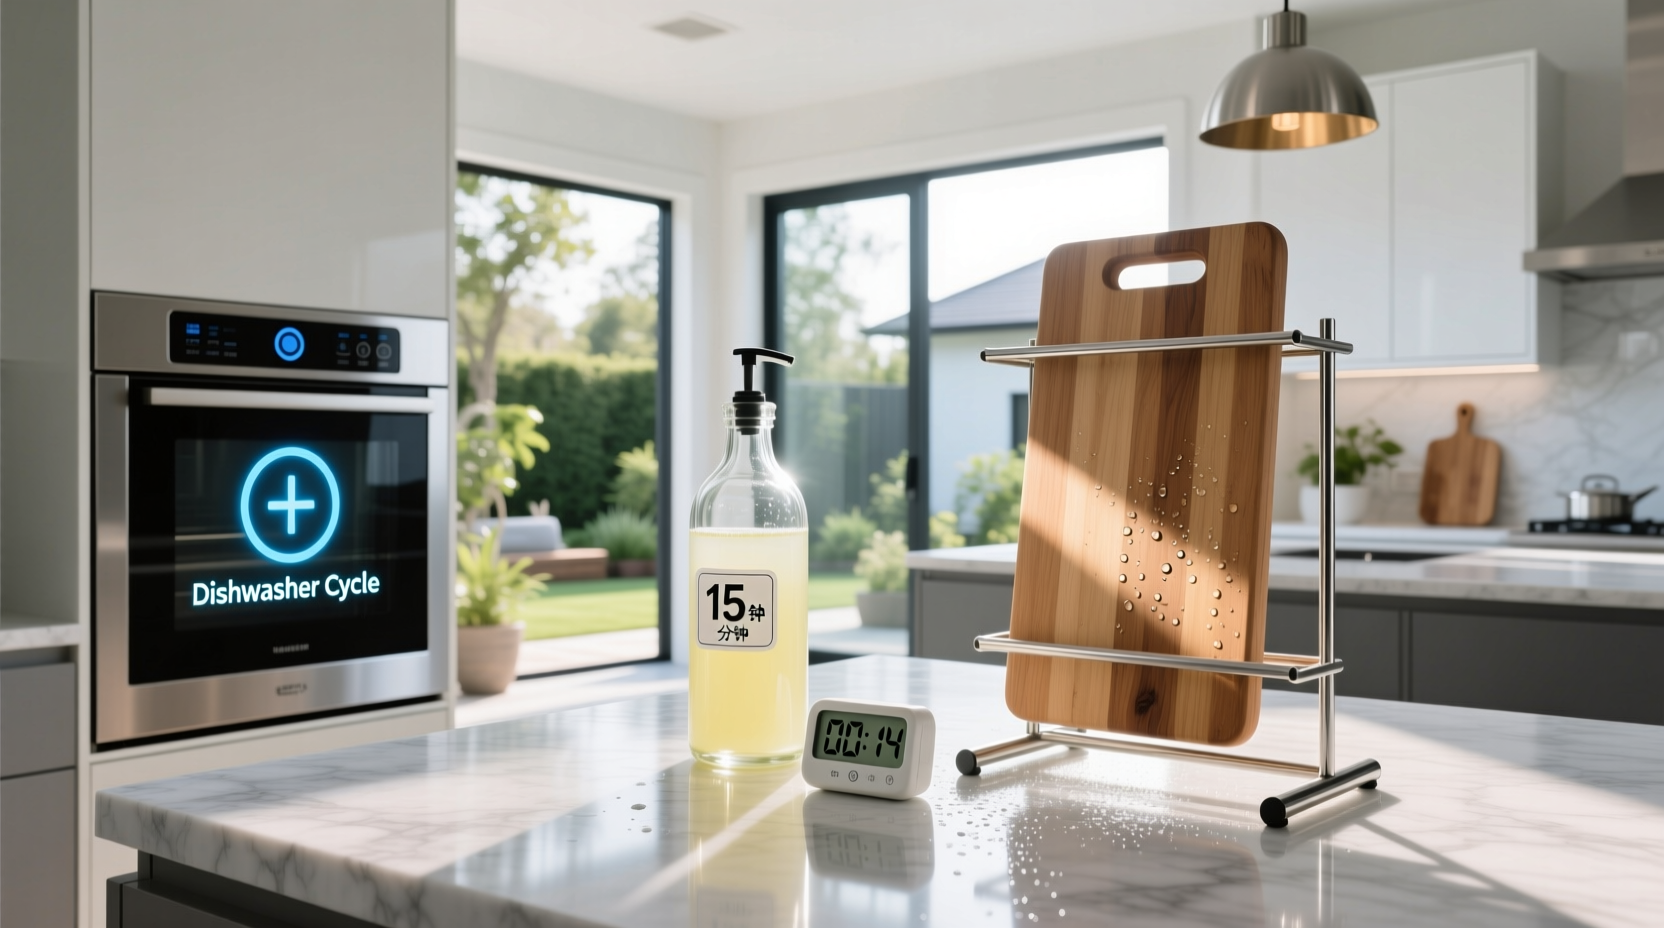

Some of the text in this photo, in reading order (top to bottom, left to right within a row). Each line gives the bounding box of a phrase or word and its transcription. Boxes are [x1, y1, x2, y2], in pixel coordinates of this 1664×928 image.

[193, 570, 380, 606] Dishwasher Cycle
[823, 718, 904, 760] 00:14
